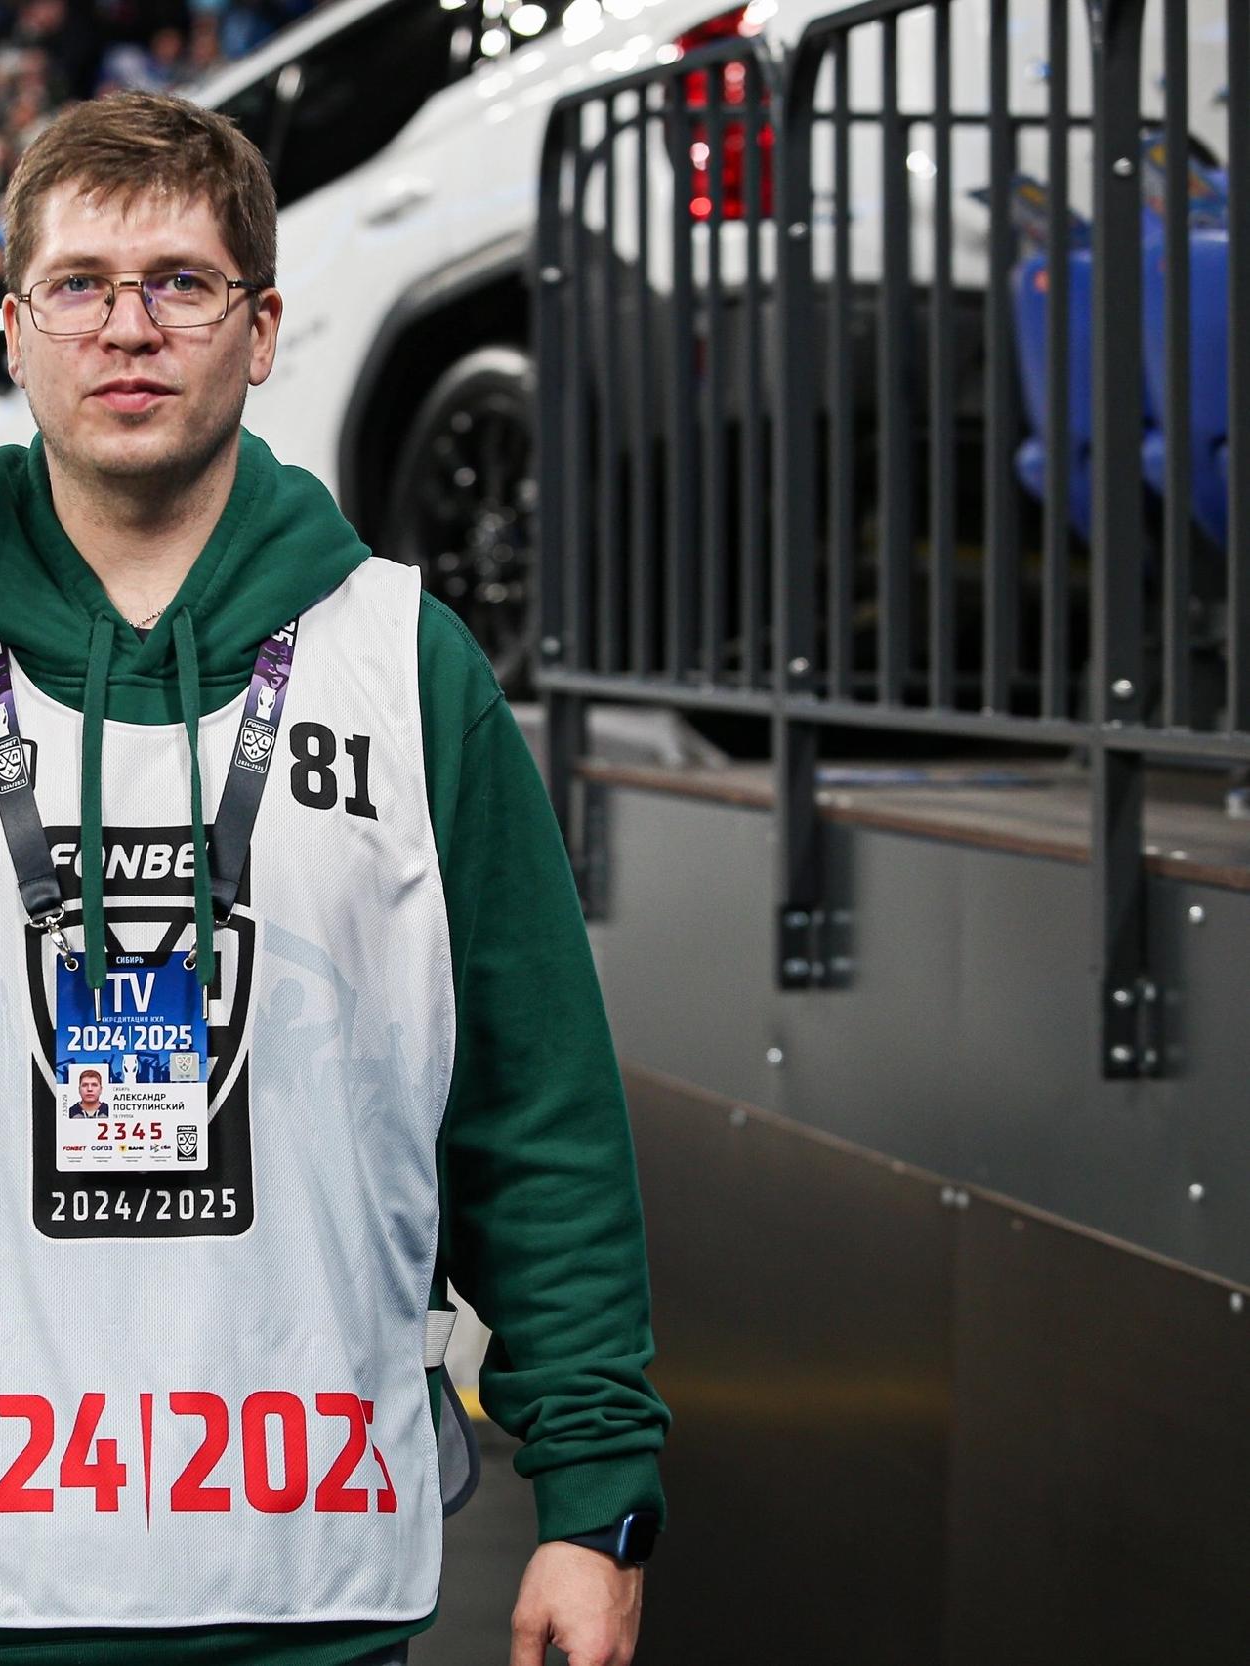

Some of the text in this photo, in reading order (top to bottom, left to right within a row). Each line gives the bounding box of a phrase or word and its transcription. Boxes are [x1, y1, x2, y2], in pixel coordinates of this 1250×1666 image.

[289, 722, 378, 821] 81
[116, 956, 145, 964] СИБИРЬ
[106, 973, 155, 1013] TV
[113, 1093, 166, 1101] АЛЕКСАНДР
[113, 1101, 185, 1111] ПОСТУПИНСКИЙ
[51, 1189, 237, 1222] 2024/2025
